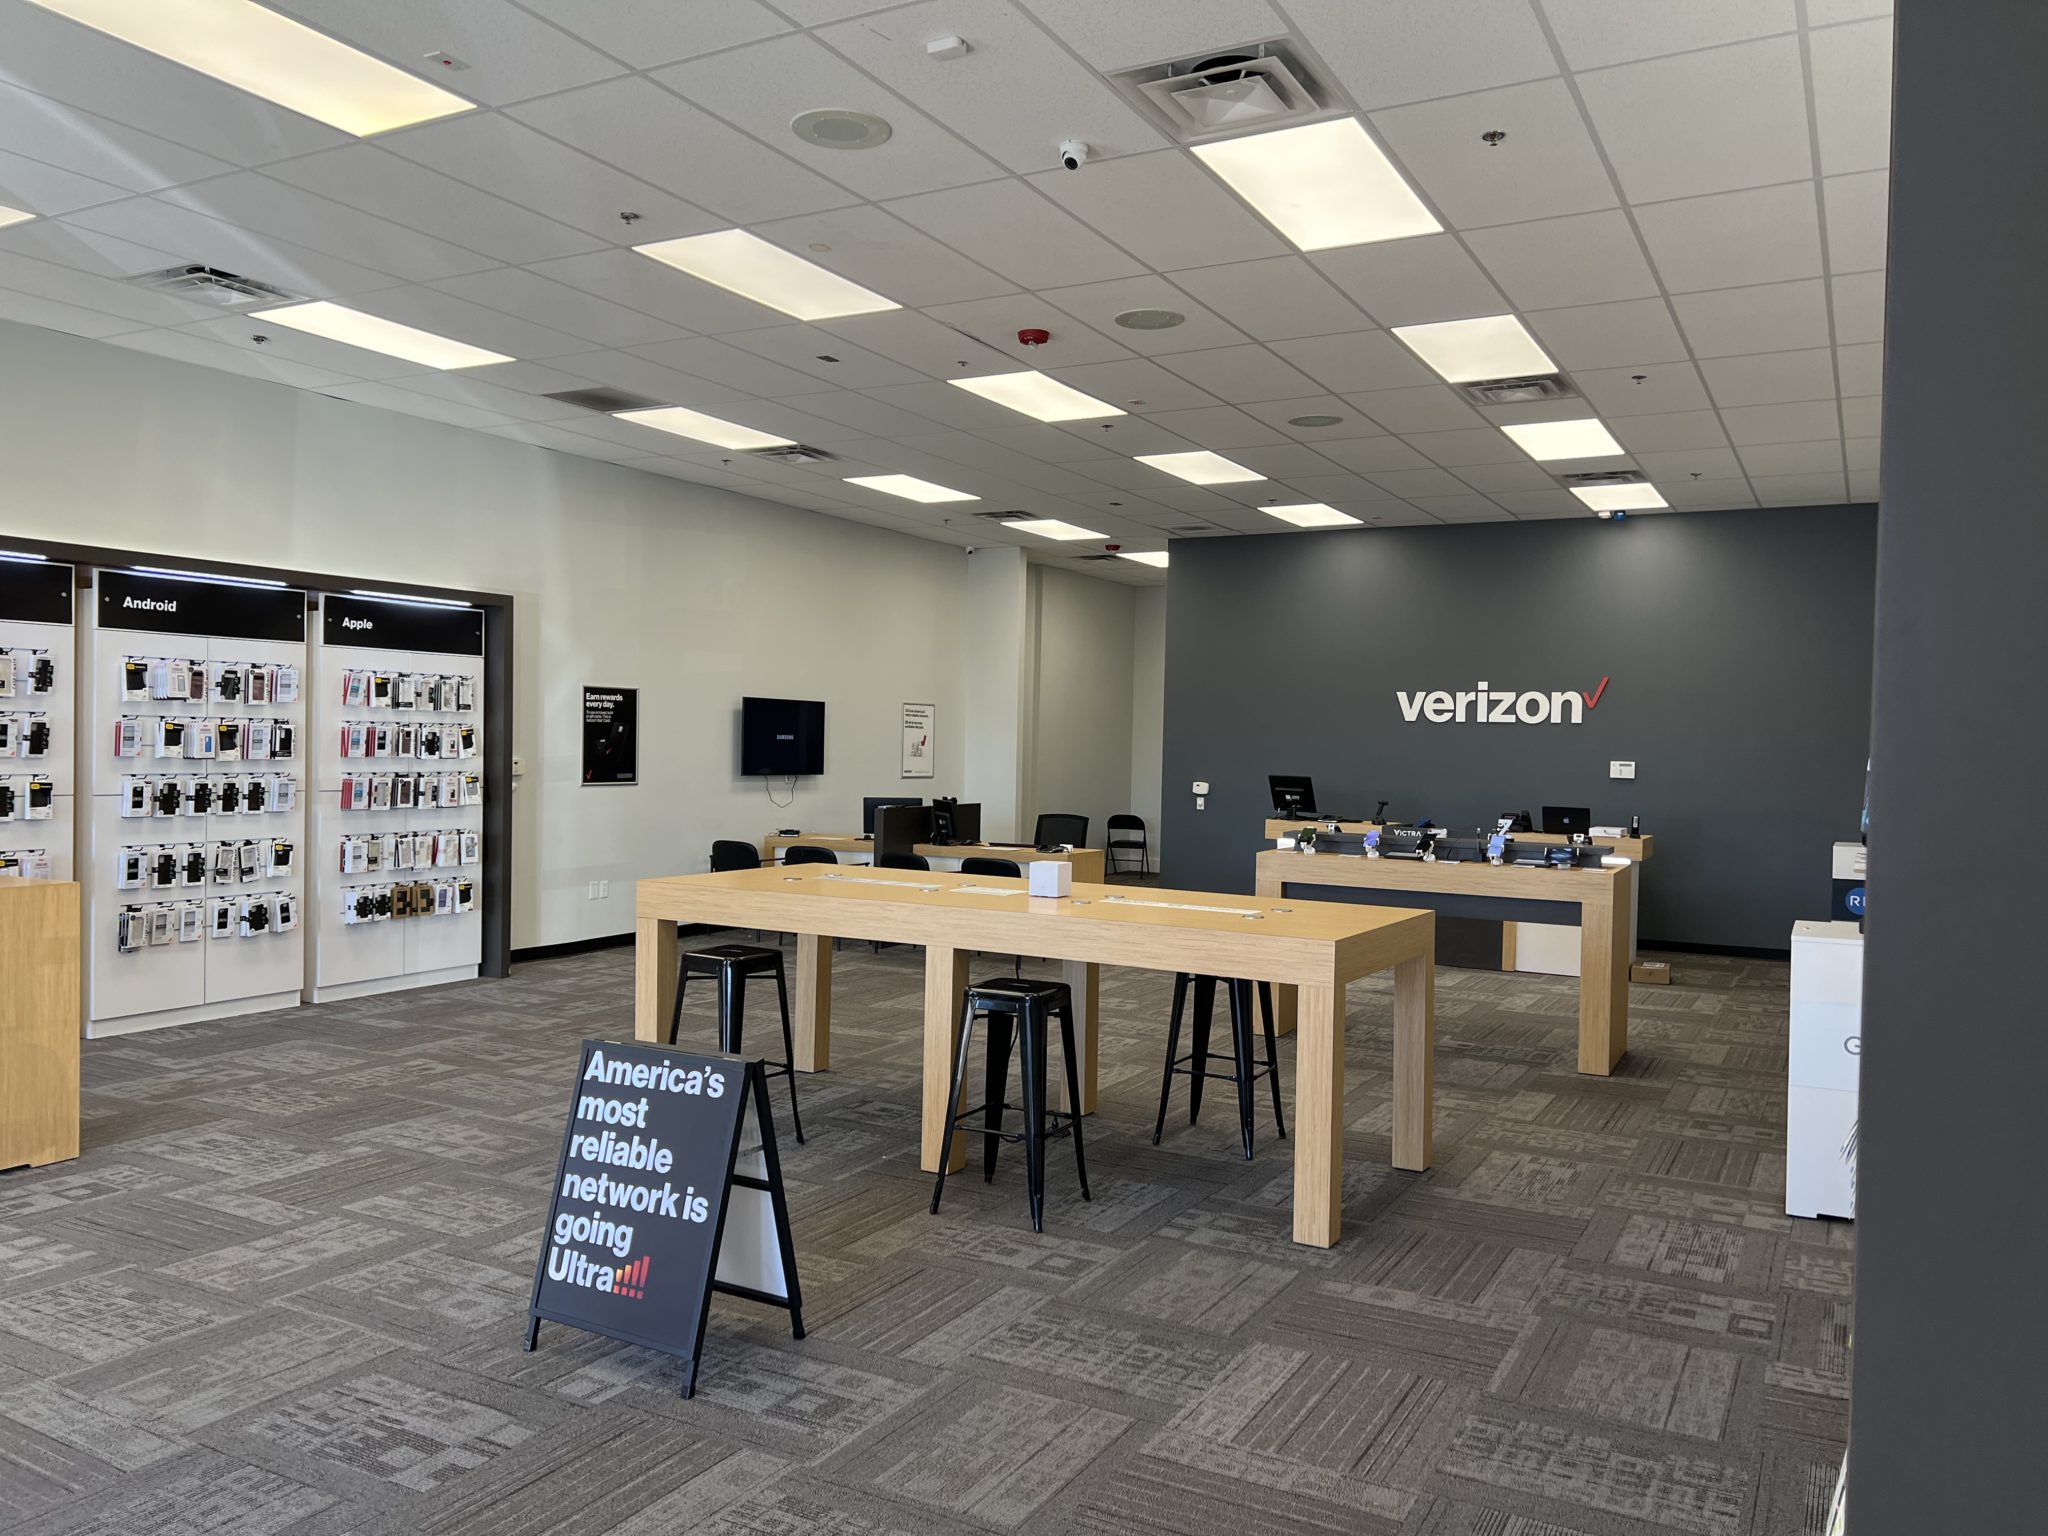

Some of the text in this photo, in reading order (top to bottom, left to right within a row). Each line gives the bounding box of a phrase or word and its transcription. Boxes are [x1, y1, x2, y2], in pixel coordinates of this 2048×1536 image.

[123, 596, 177, 612] Android
[342, 617, 373, 630] Apple
[586, 692, 623, 701] Earn rewards
[586, 700, 615, 709] every day.
[1396, 681, 1583, 724] verizon
[1393, 829, 1422, 837] VICTRA
[583, 1051, 726, 1098] America's
[576, 1095, 649, 1129] most
[569, 1130, 673, 1174] reliable
[561, 1173, 709, 1223] network is
[554, 1211, 634, 1258] going
[548, 1246, 615, 1293] Ultra
